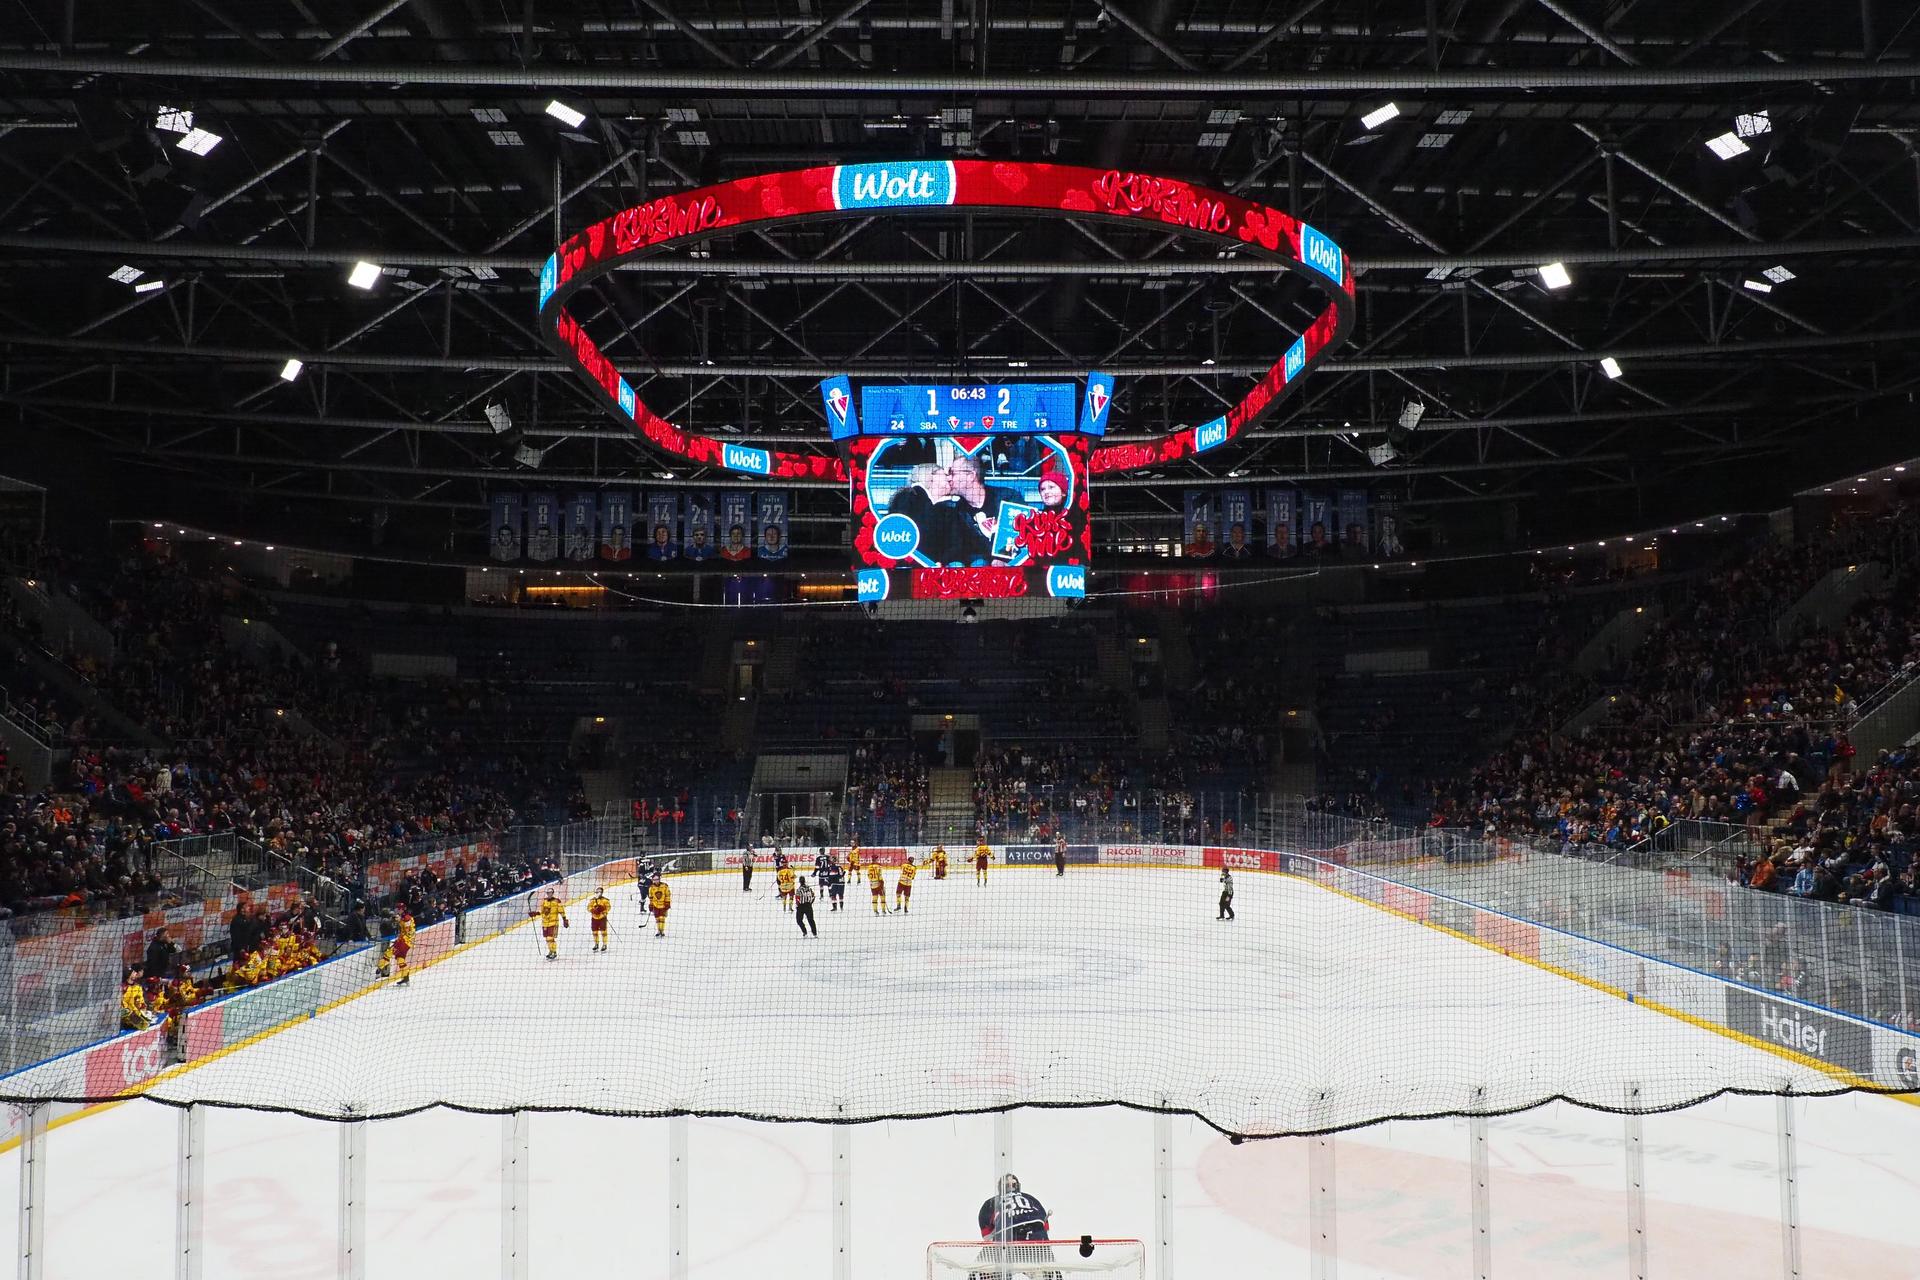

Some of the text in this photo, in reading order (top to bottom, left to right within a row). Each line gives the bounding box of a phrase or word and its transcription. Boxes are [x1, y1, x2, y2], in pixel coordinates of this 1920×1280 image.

[854, 168, 935, 200] Wolt
[1309, 236, 1337, 274] Wolt
[926, 389, 939, 416] 1
[951, 388, 986, 400] 06:43
[998, 388, 1010, 414] 2
[890, 420, 905, 430] 24
[920, 422, 937, 430] SBA
[1002, 421, 1018, 429] TRE
[1034, 418, 1047, 428] 13
[1202, 424, 1222, 446] Wolt
[729, 452, 762, 470] Wolt
[728, 505, 745, 524] 15
[762, 505, 784, 524] 22
[1229, 503, 1245, 522] 18
[881, 530, 911, 543] Wolt
[1106, 848, 1142, 856] RICOH
[1152, 848, 1186, 856] RICOH
[1760, 1003, 1827, 1056] Haier
